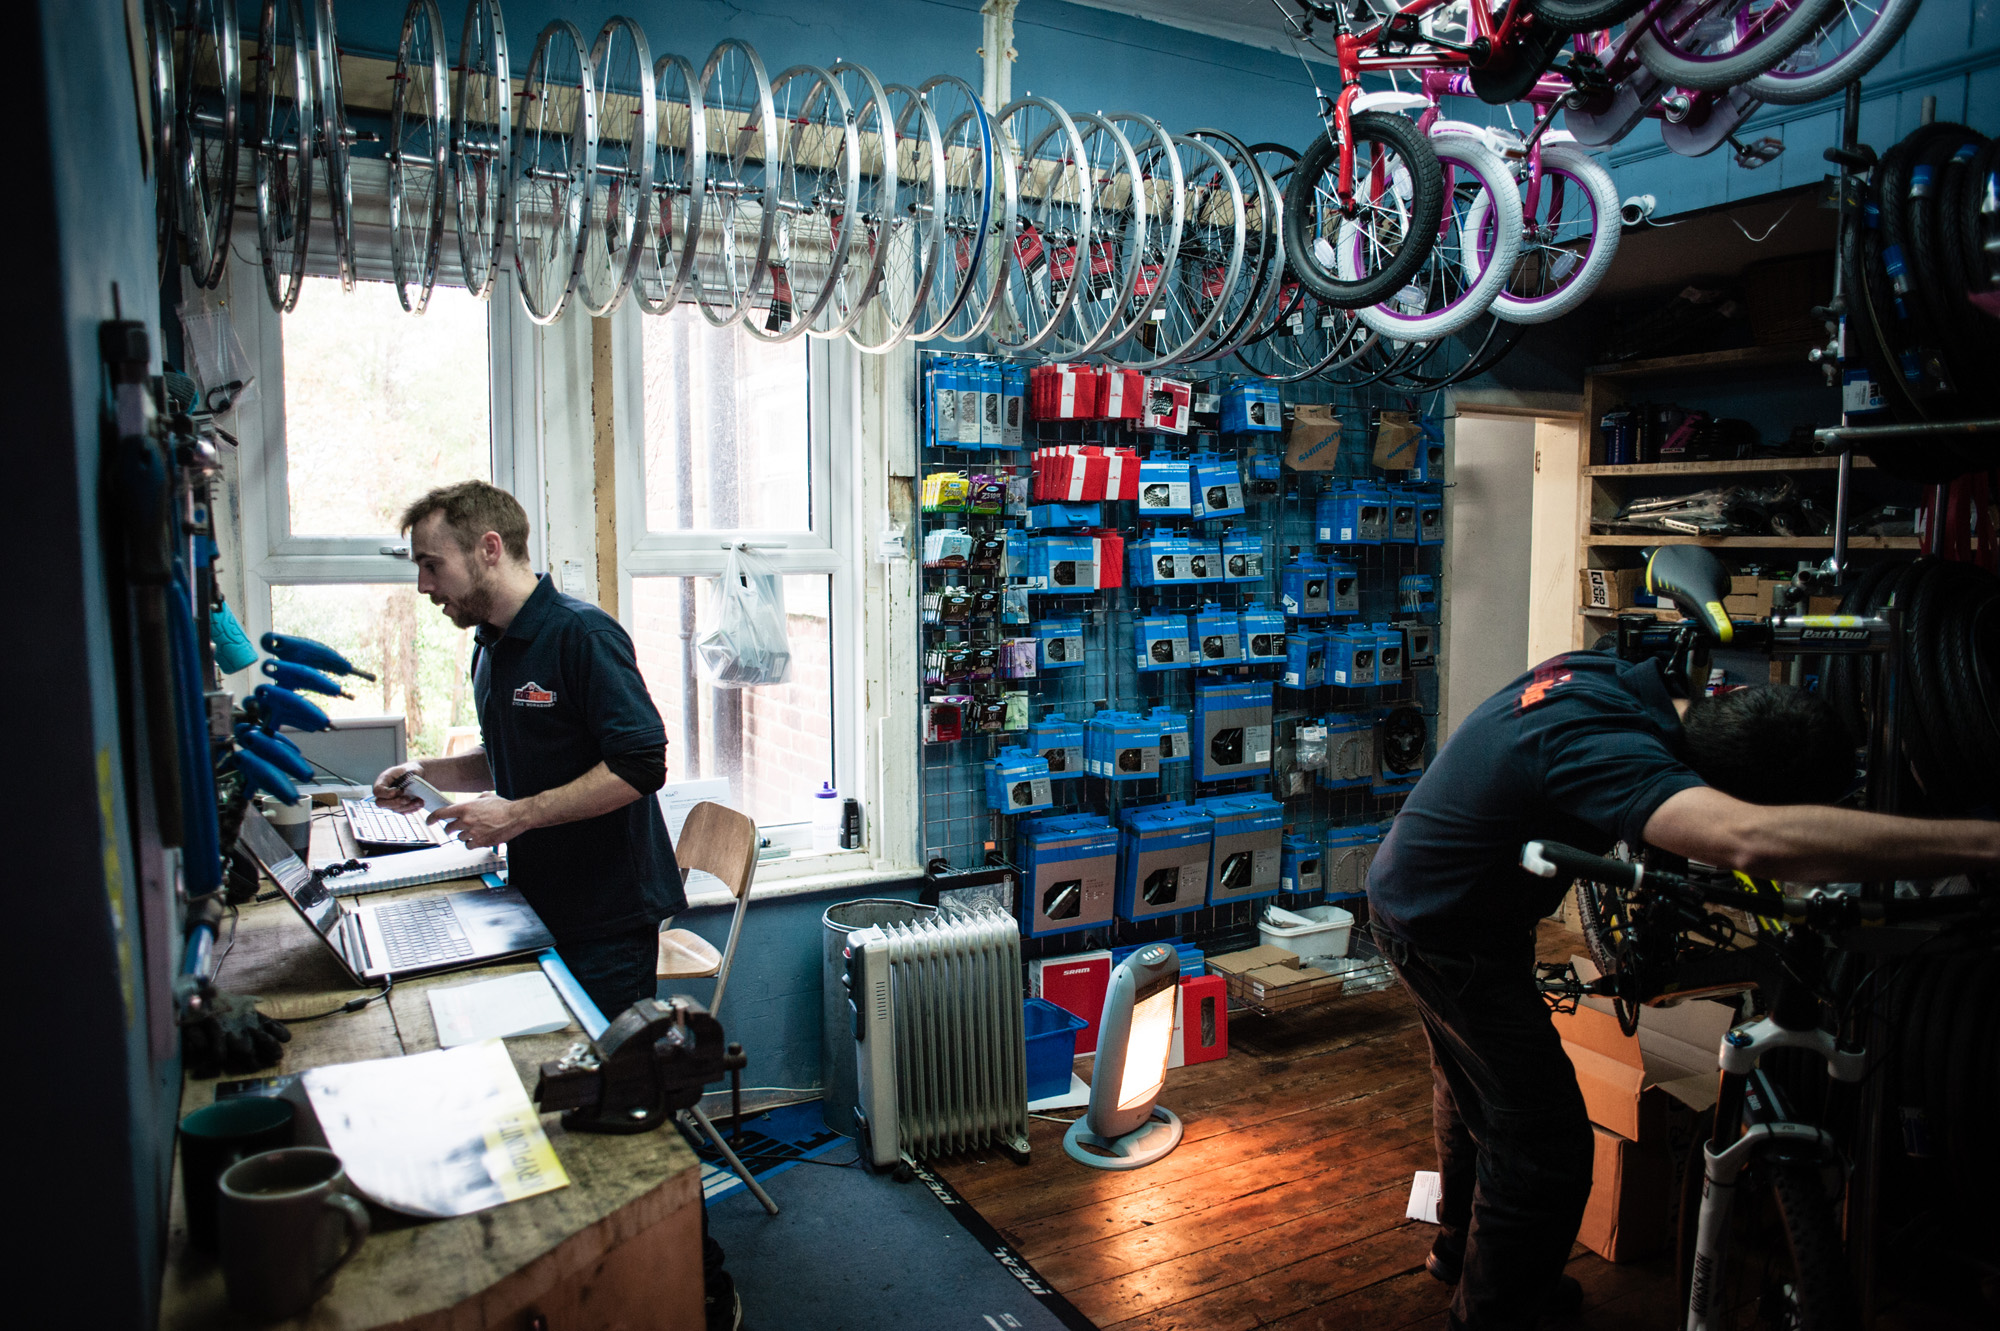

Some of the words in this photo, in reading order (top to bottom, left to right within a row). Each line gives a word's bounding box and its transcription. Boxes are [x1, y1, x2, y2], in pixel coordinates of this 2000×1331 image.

[1802, 629, 1836, 639] Park
[1837, 630, 1870, 640] Tool
[1063, 967, 1090, 976] SRAM
[994, 1246, 1053, 1295] IDEAL
